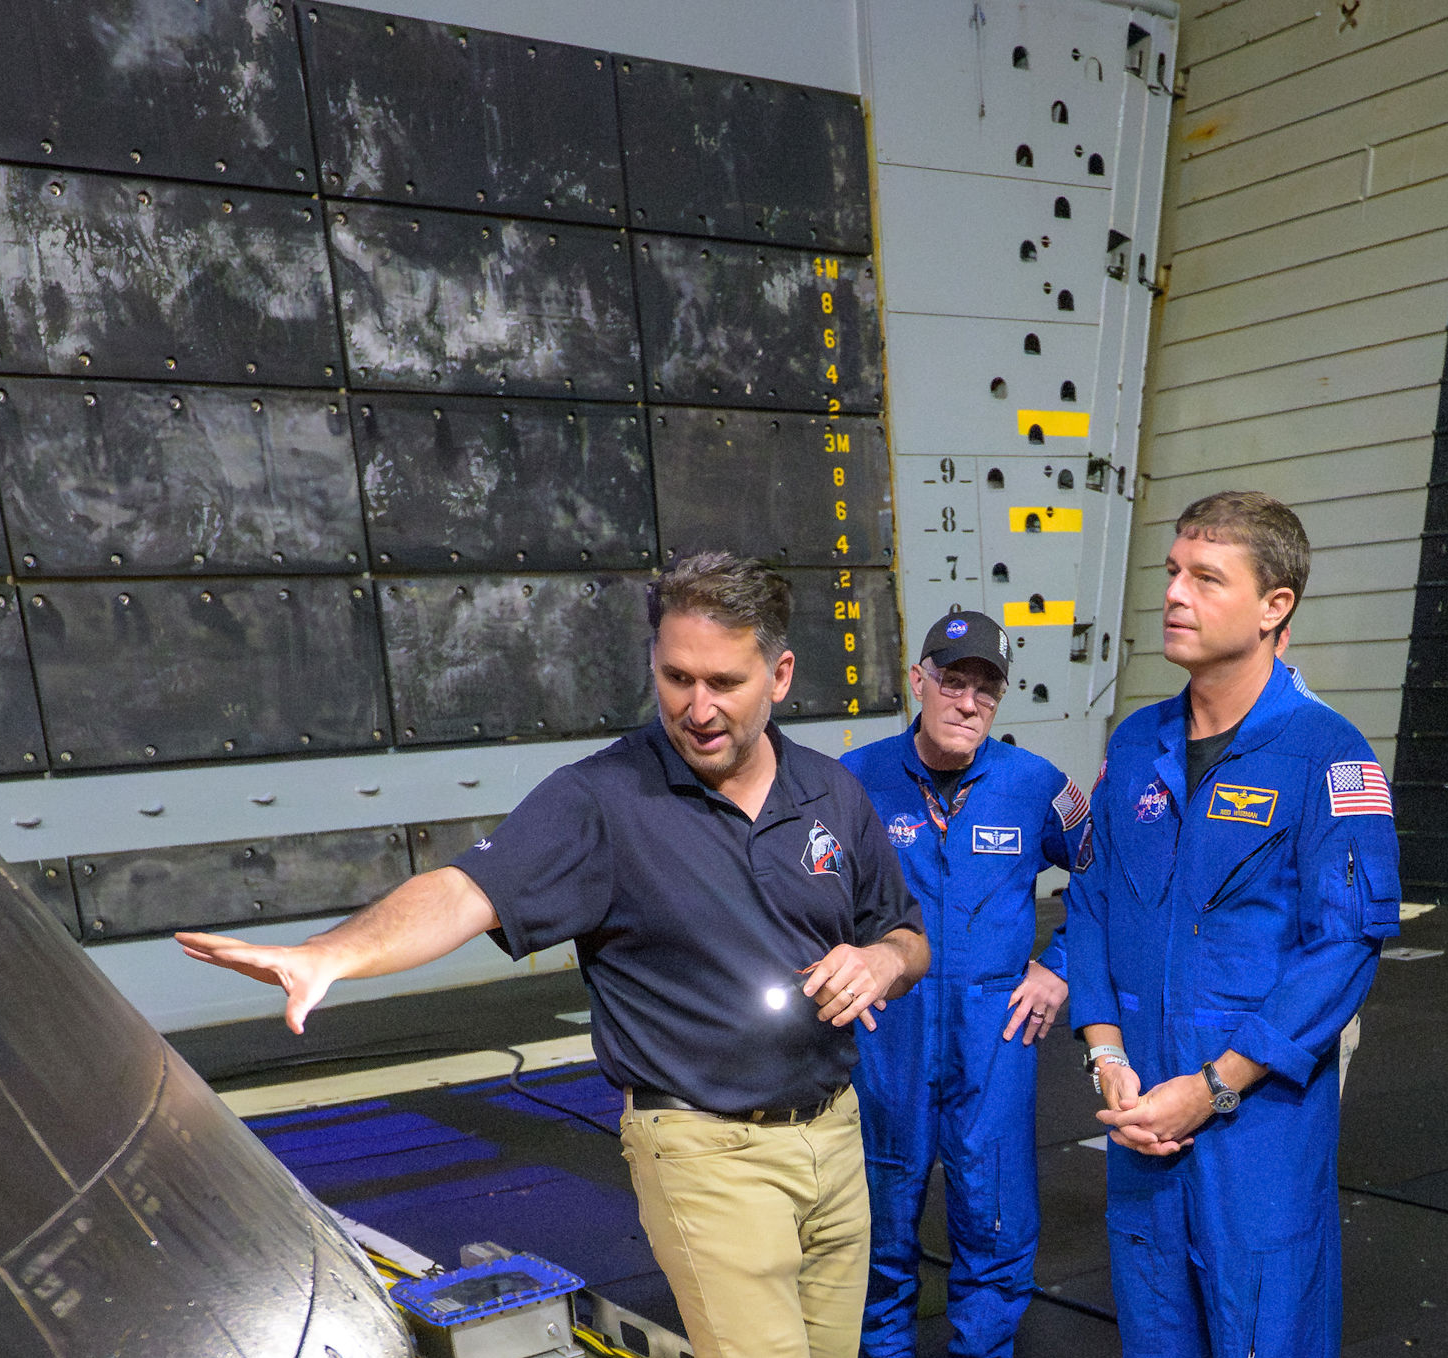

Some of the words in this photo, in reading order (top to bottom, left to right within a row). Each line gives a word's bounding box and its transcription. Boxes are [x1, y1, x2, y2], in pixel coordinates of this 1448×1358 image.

[821, 292, 833, 314] 8
[823, 328, 836, 349] 6
[826, 364, 839, 385] 4
[828, 399, 841, 420] 2
[825, 433, 851, 453] 3M
[833, 467, 845, 487] 8
[940, 457, 955, 483] 9
[835, 501, 847, 520] 6
[942, 506, 956, 532] 8
[836, 535, 849, 554] 4
[946, 555, 958, 581] 7
[840, 570, 851, 588] 2
[834, 601, 861, 620] 2M
[844, 633, 855, 652] 8
[846, 666, 858, 684] 6
[848, 699, 859, 716] 4
[888, 824, 916, 839] NASA
